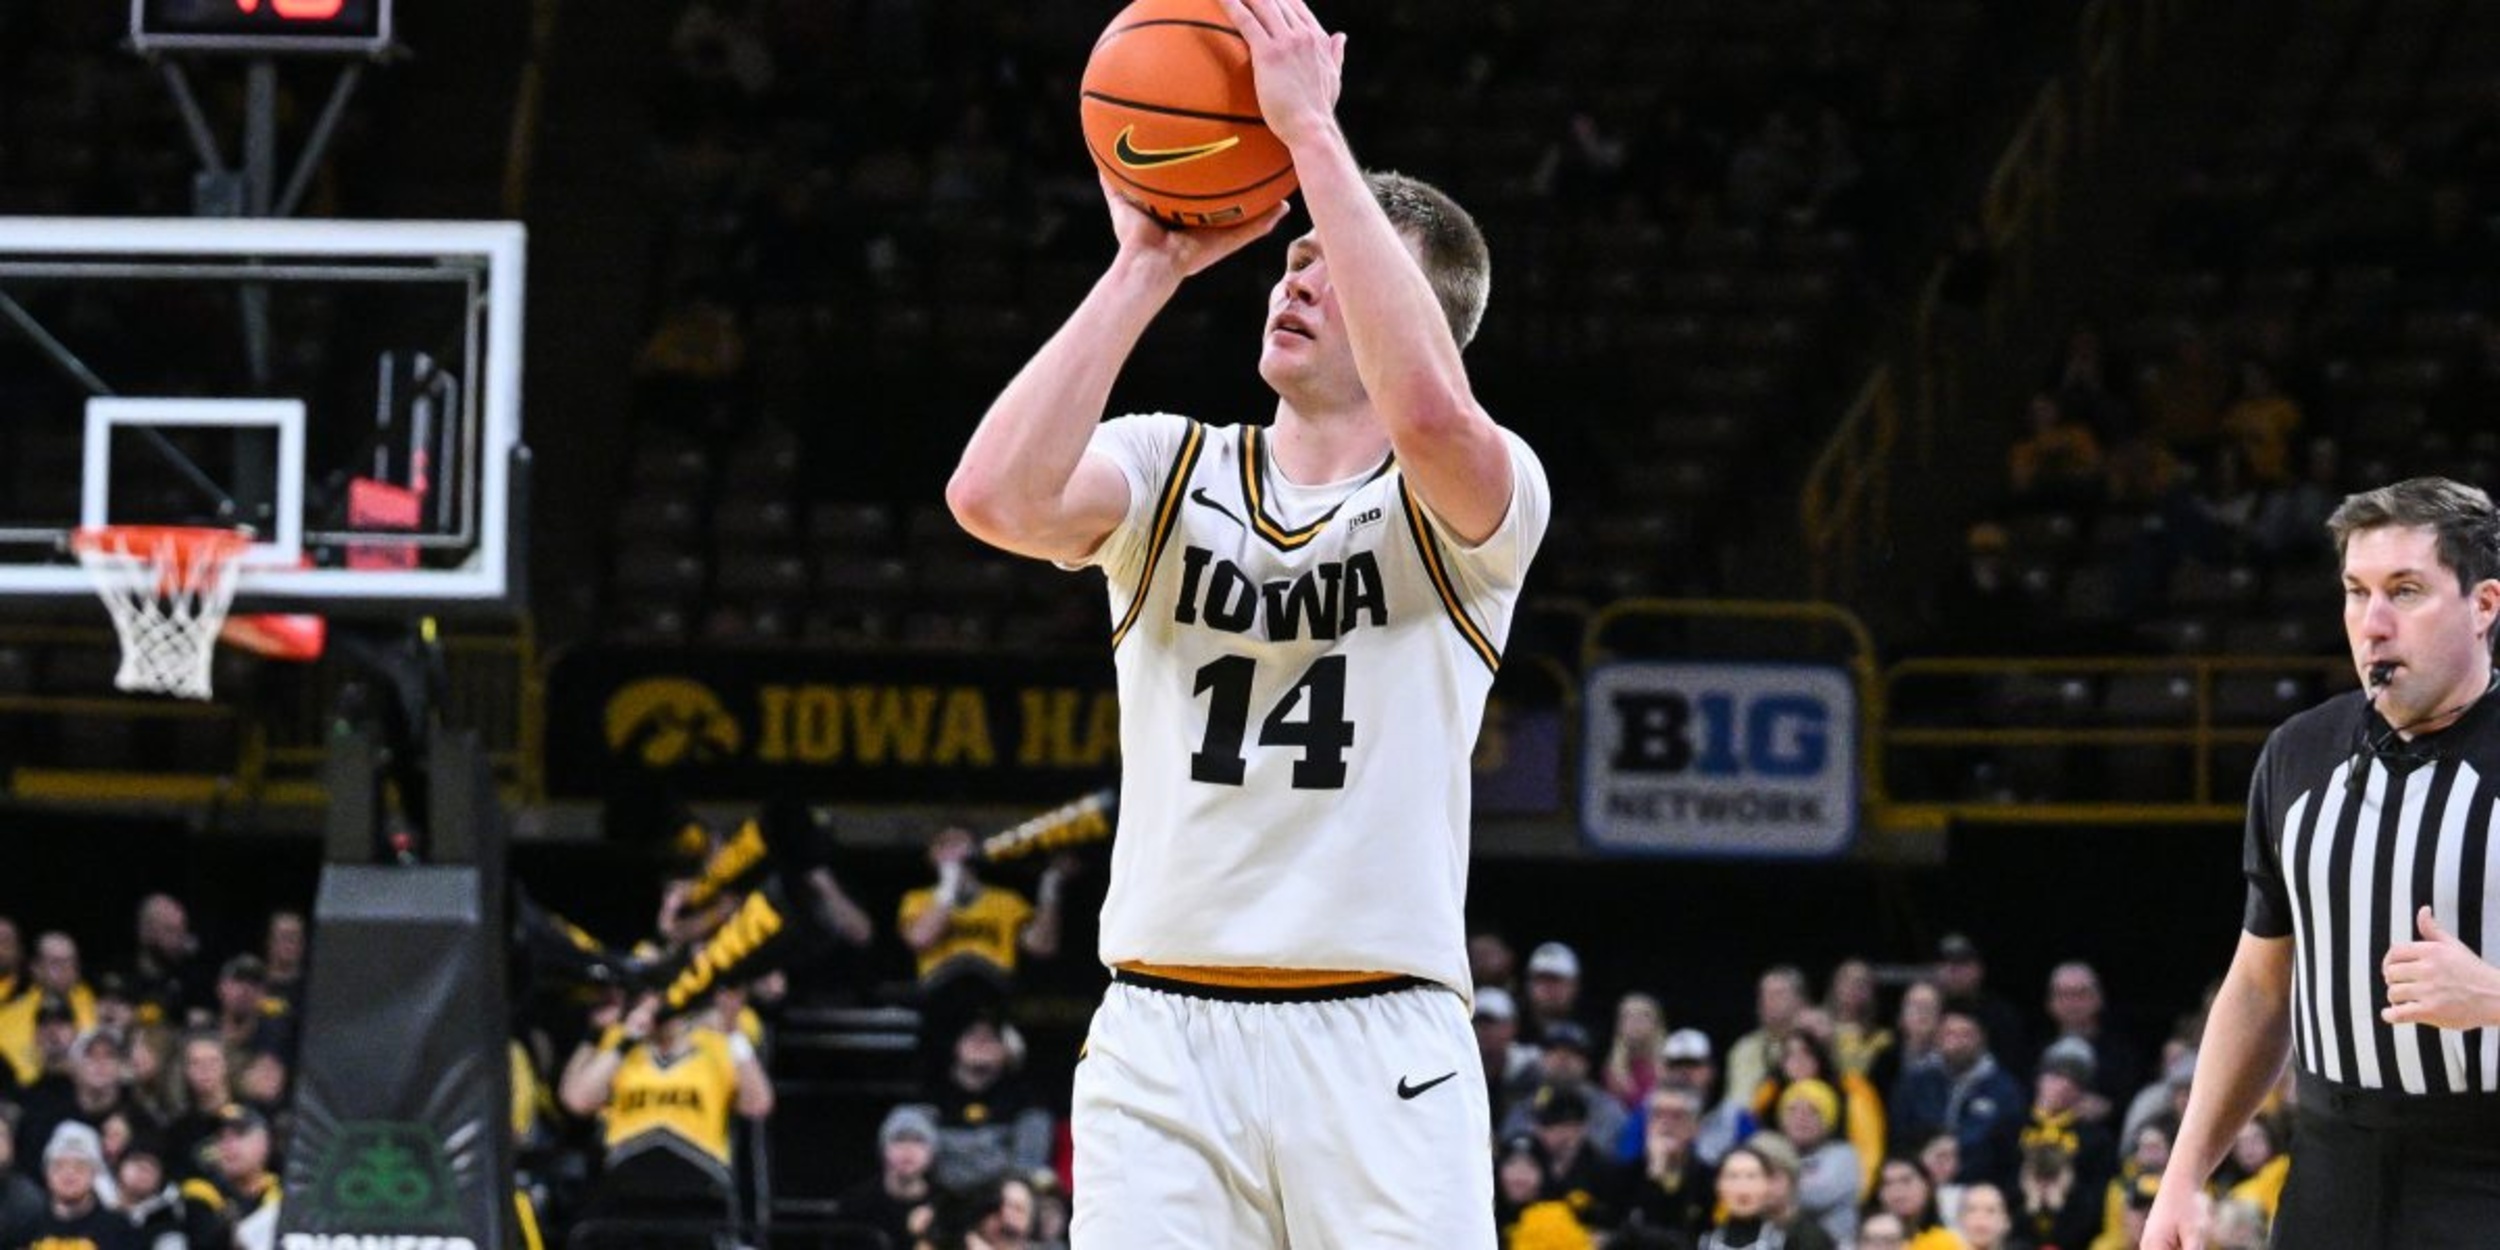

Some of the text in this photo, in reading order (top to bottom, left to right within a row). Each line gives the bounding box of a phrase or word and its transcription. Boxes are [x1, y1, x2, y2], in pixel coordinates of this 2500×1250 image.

[1175, 546, 1388, 642] IOWA
[756, 685, 995, 765] IOWA
[1190, 655, 1355, 789] 14
[1606, 793, 1822, 823] NETWORK
